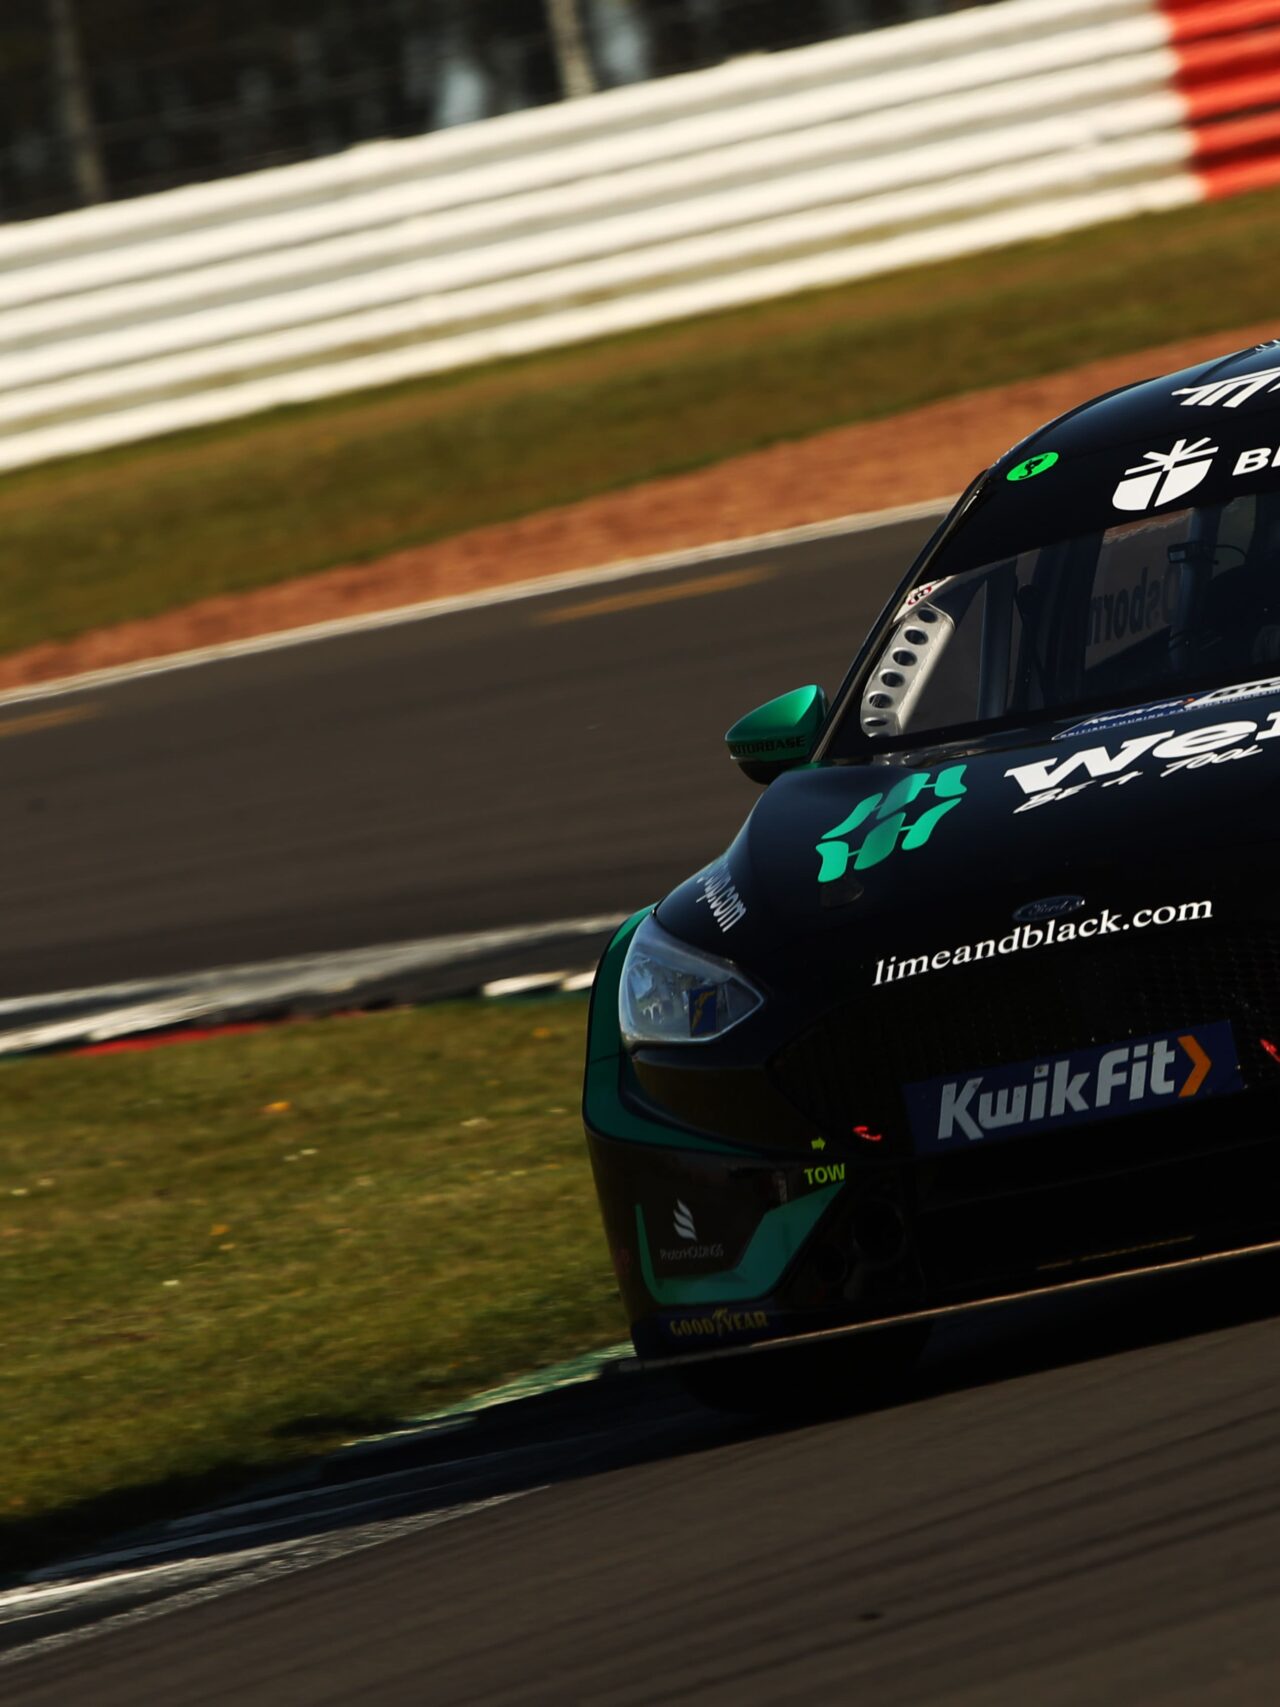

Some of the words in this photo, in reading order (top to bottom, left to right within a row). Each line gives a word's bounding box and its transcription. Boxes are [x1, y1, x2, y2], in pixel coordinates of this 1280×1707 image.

[1013, 780, 1097, 814] BE
[1102, 771, 1144, 788] A
[1160, 745, 1264, 778] TOOL
[872, 899, 1214, 987] limeandblack.com
[802, 1161, 847, 1186] TOW
